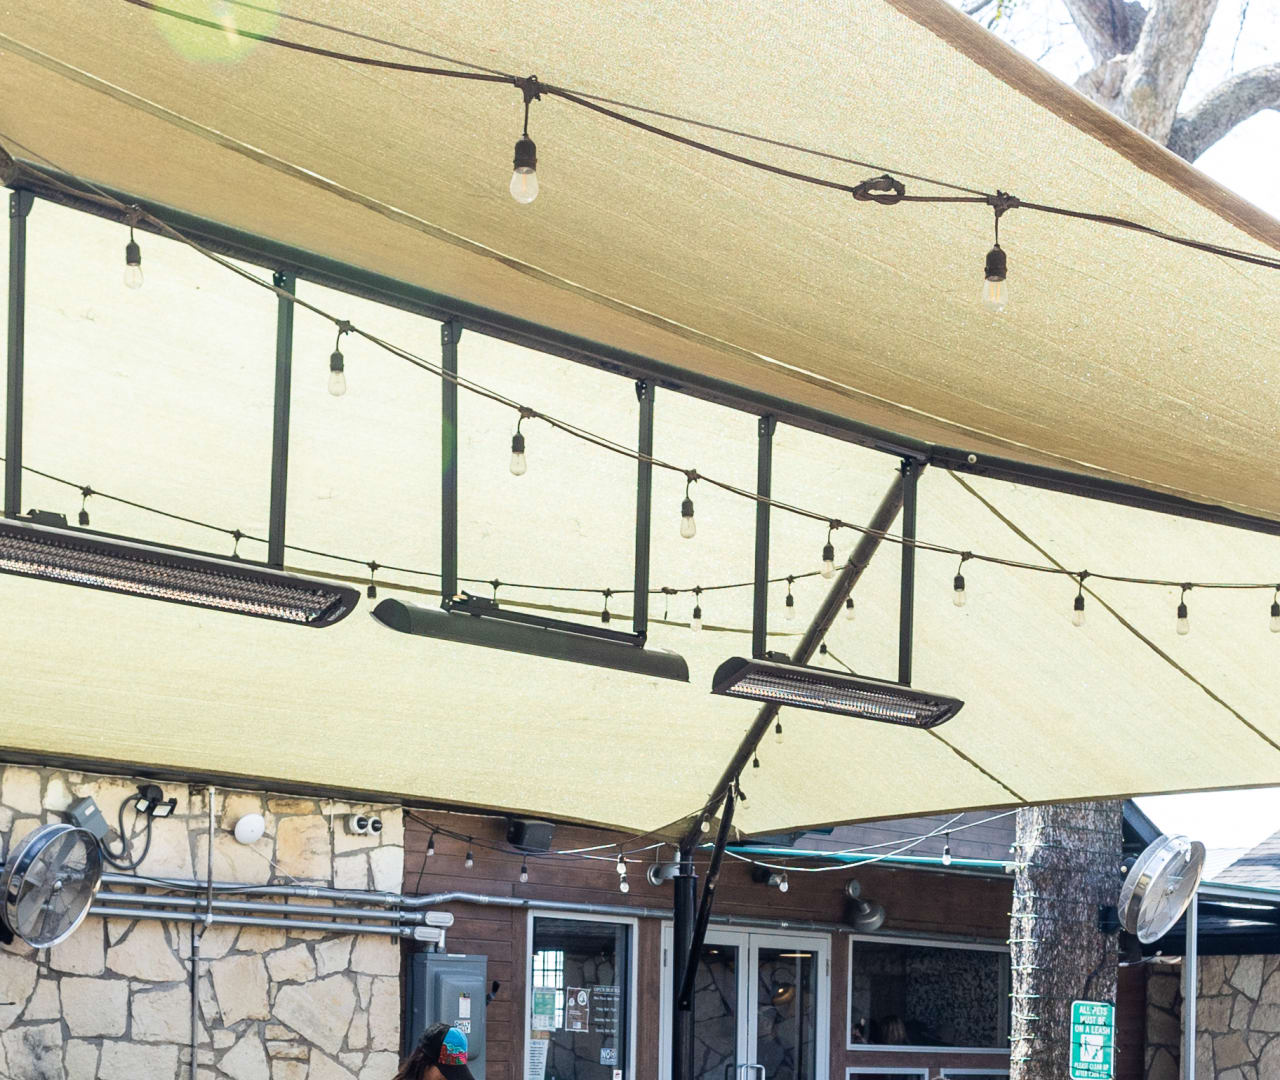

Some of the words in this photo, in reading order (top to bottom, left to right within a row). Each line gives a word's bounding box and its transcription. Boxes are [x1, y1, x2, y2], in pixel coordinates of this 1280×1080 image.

[1079, 1005, 1090, 1014] ALL
[1092, 1006, 1108, 1015] PETS
[1080, 1015, 1096, 1024] MUST
[1074, 1024, 1084, 1032] ON
[1085, 1025, 1090, 1033] A
[1091, 1025, 1110, 1035] LEASH
